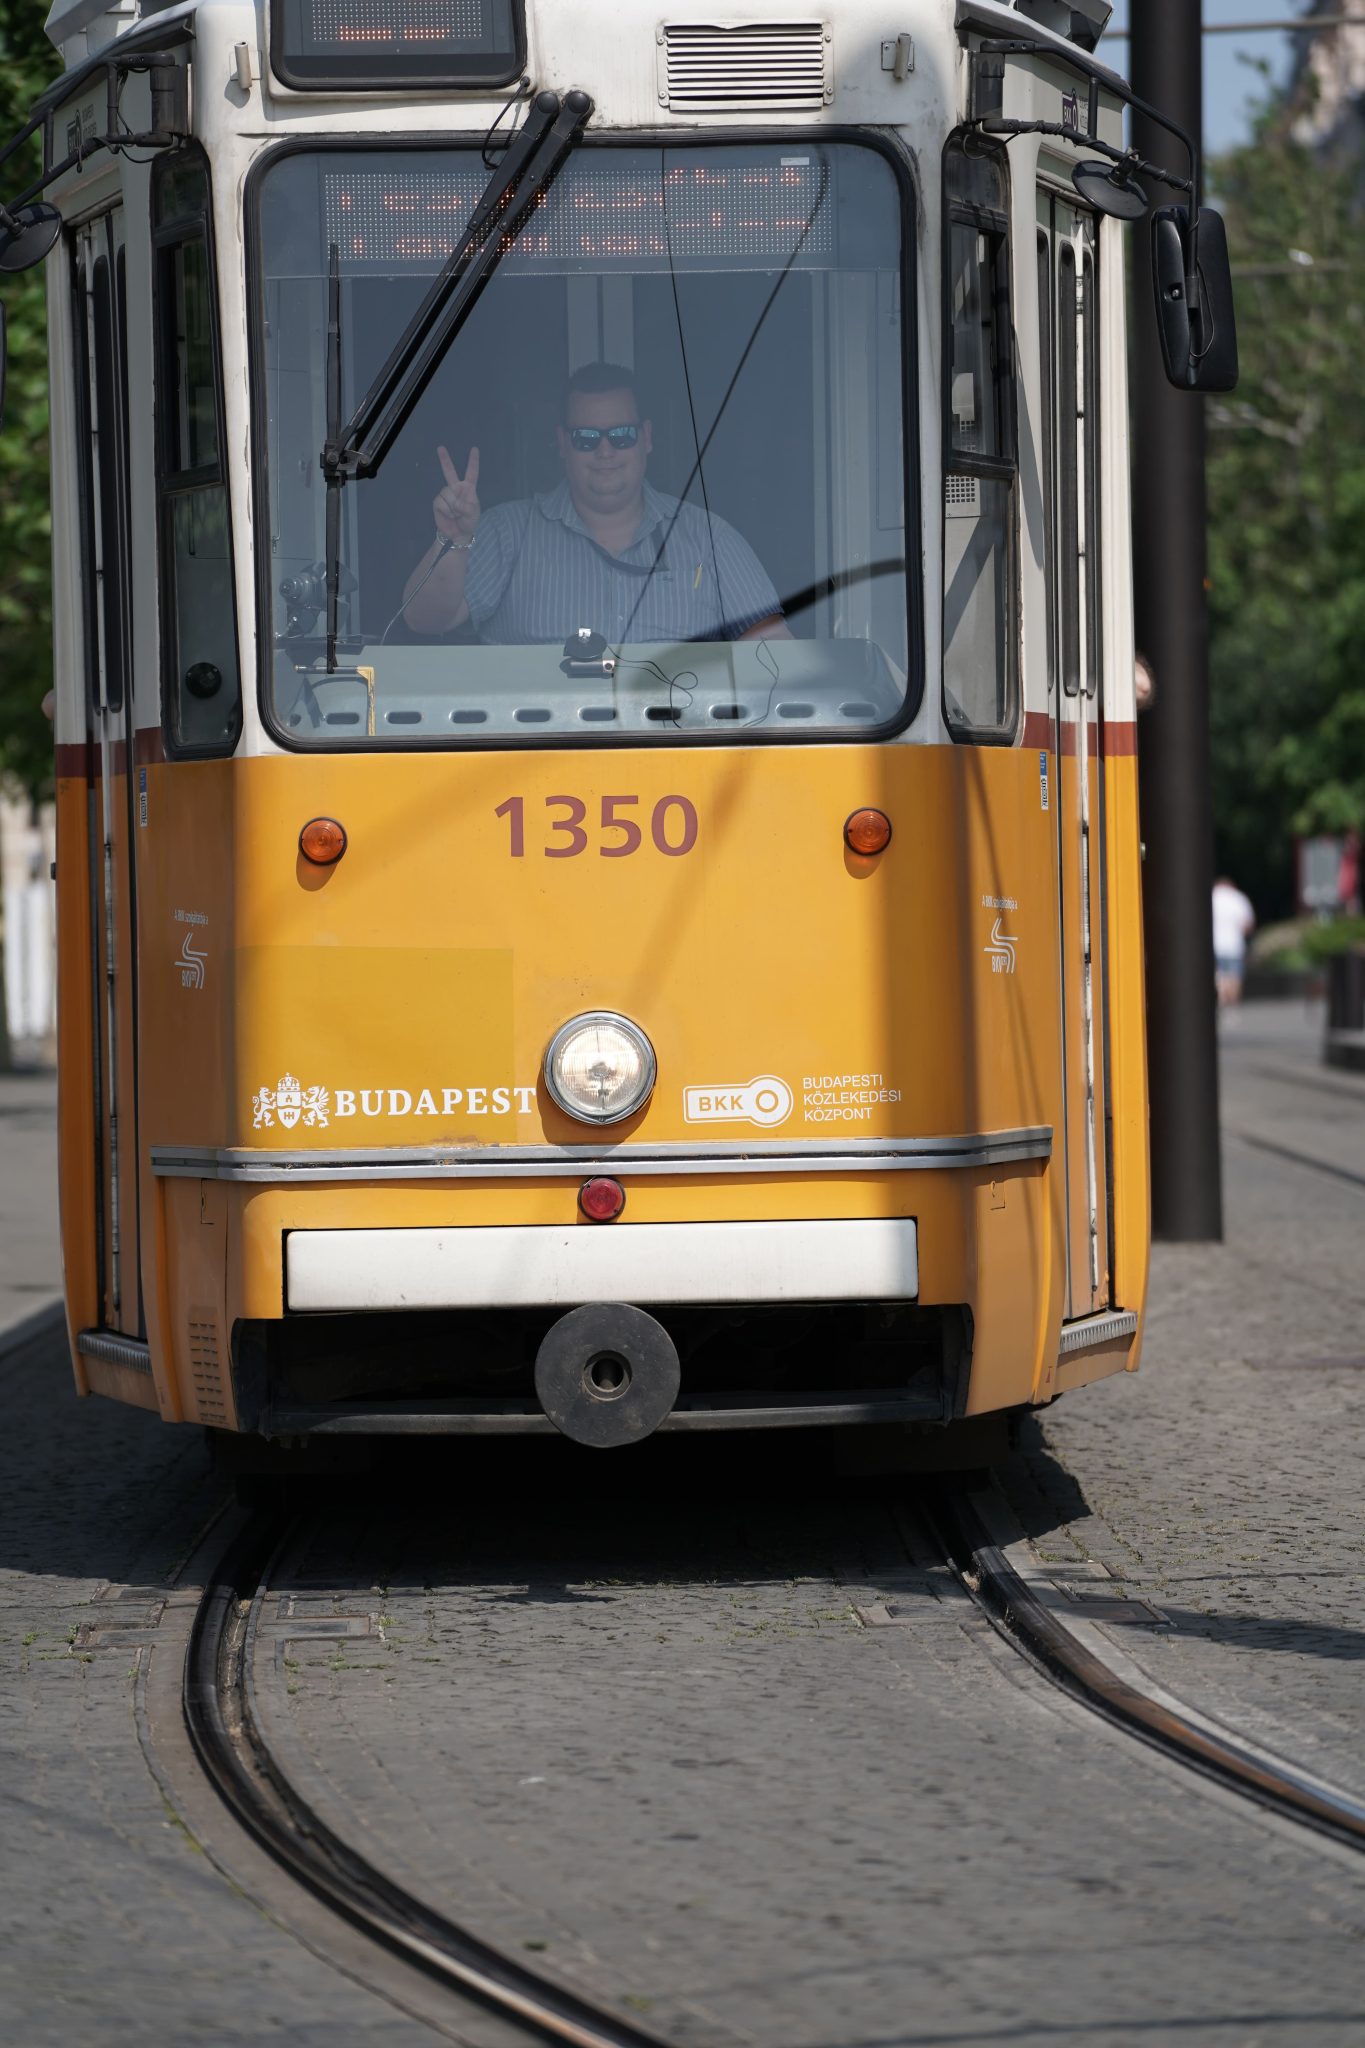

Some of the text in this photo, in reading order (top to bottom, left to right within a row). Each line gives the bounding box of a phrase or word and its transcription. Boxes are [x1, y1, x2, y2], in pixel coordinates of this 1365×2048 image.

[494, 795, 698, 858] 1350
[803, 1074, 883, 1090] BUDAPESTI
[334, 1087, 537, 1116] BUDAPEST
[699, 1095, 743, 1112] BKK
[803, 1089, 902, 1106] KÖZLEKEDÉSI
[804, 1107, 873, 1122] KÖZPONT
